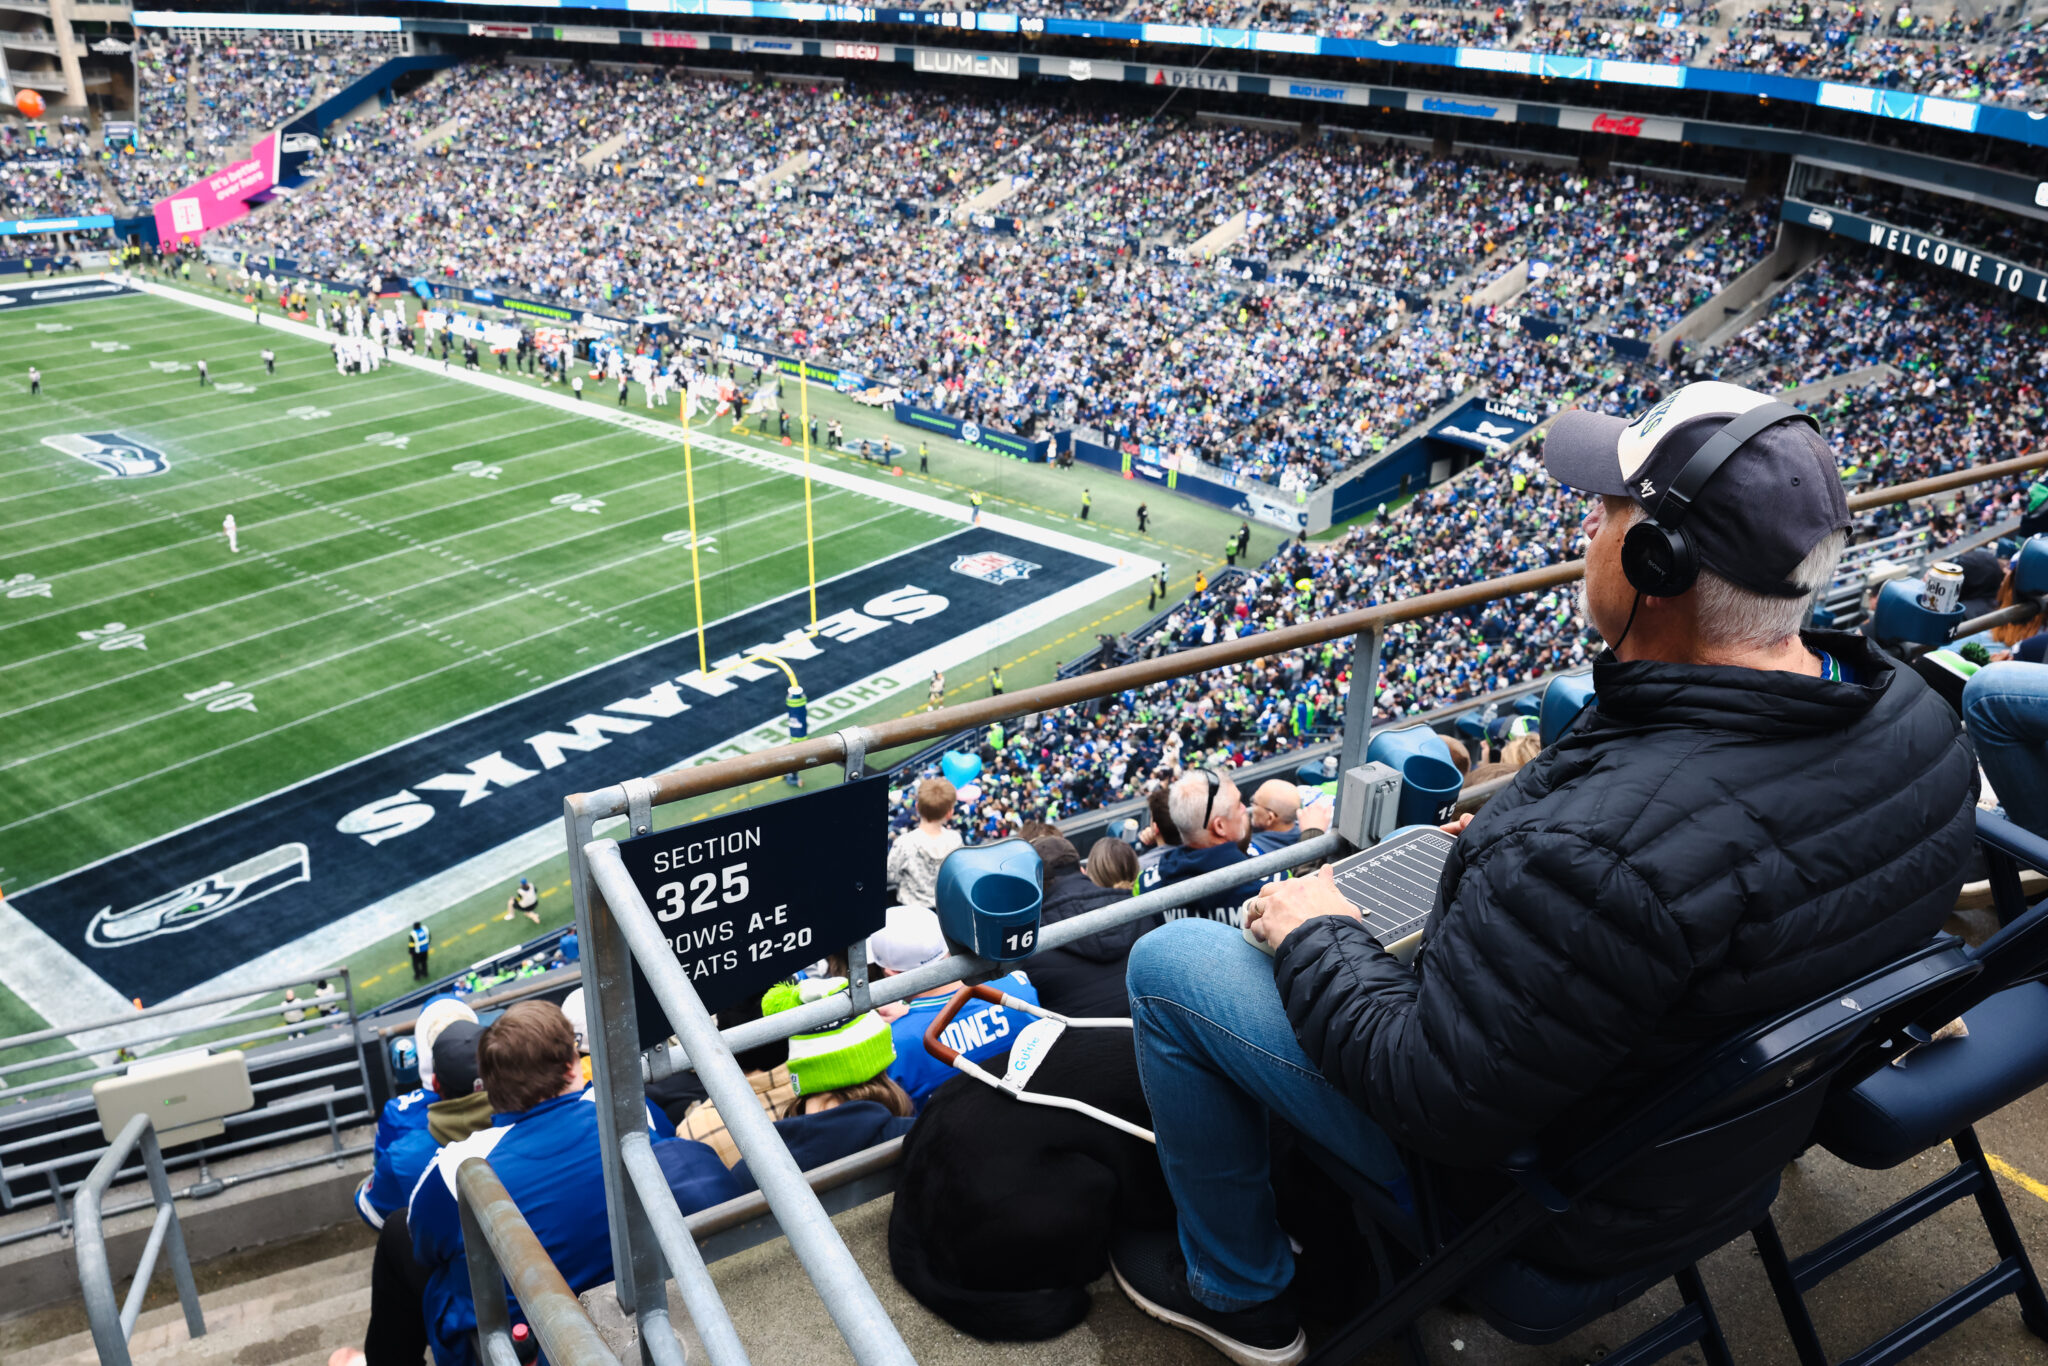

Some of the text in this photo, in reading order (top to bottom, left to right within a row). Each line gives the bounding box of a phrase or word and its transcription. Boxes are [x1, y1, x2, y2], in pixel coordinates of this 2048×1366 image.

[920, 52, 1009, 76] LUMEN
[1172, 71, 1229, 90] DELTA
[1869, 223, 1982, 277] WELCOME
[1994, 262, 2023, 293] TO
[1485, 401, 1538, 424] LUMEN
[183, 681, 255, 713] 10
[336, 584, 950, 846] SEAHAWKS
[1438, 804, 1456, 821] 15
[654, 826, 762, 873] SECTION
[656, 862, 750, 922] 325
[747, 904, 789, 934] A-E
[681, 927, 812, 981] ATS 12-20
[1006, 930, 1034, 951] 16
